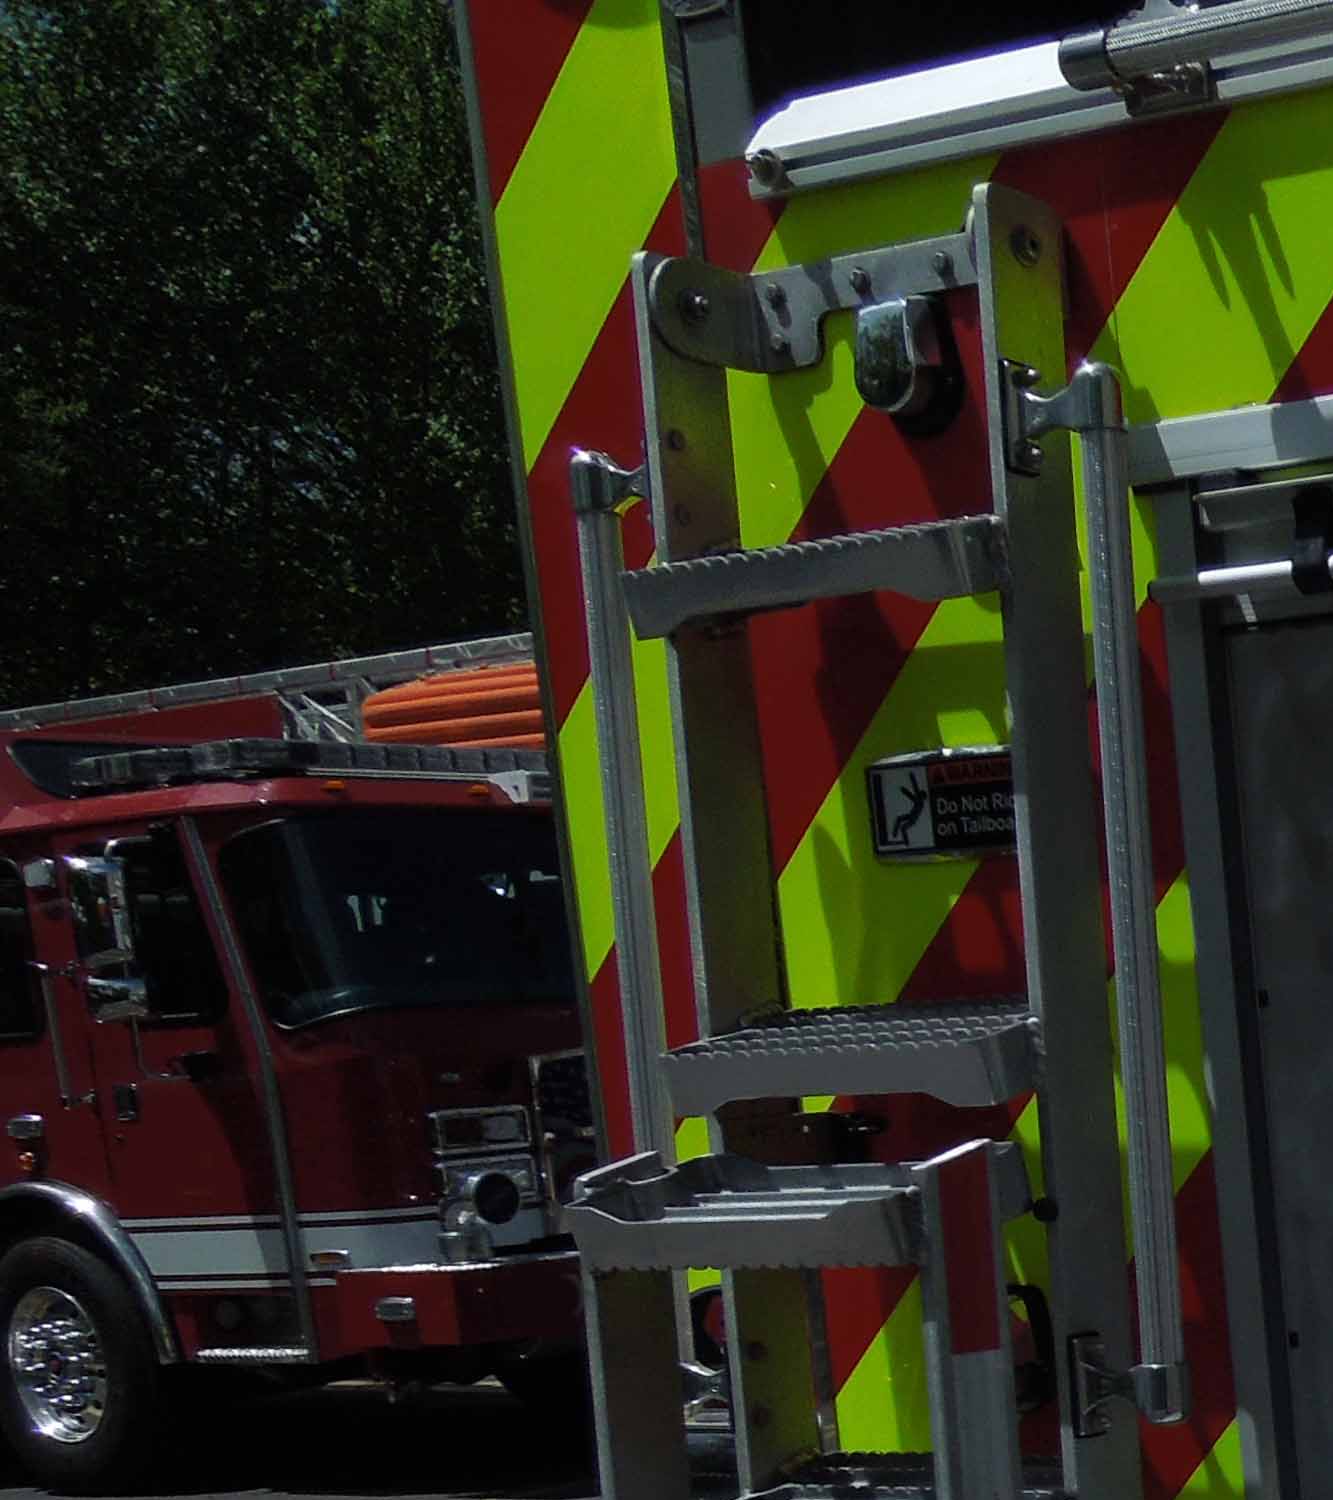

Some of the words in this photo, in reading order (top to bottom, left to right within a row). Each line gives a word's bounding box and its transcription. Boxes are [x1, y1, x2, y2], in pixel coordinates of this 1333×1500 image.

[936, 796, 959, 815] Do
[960, 793, 989, 812] Not
[936, 820, 959, 836] on
[959, 814, 1015, 833] Tailboa
